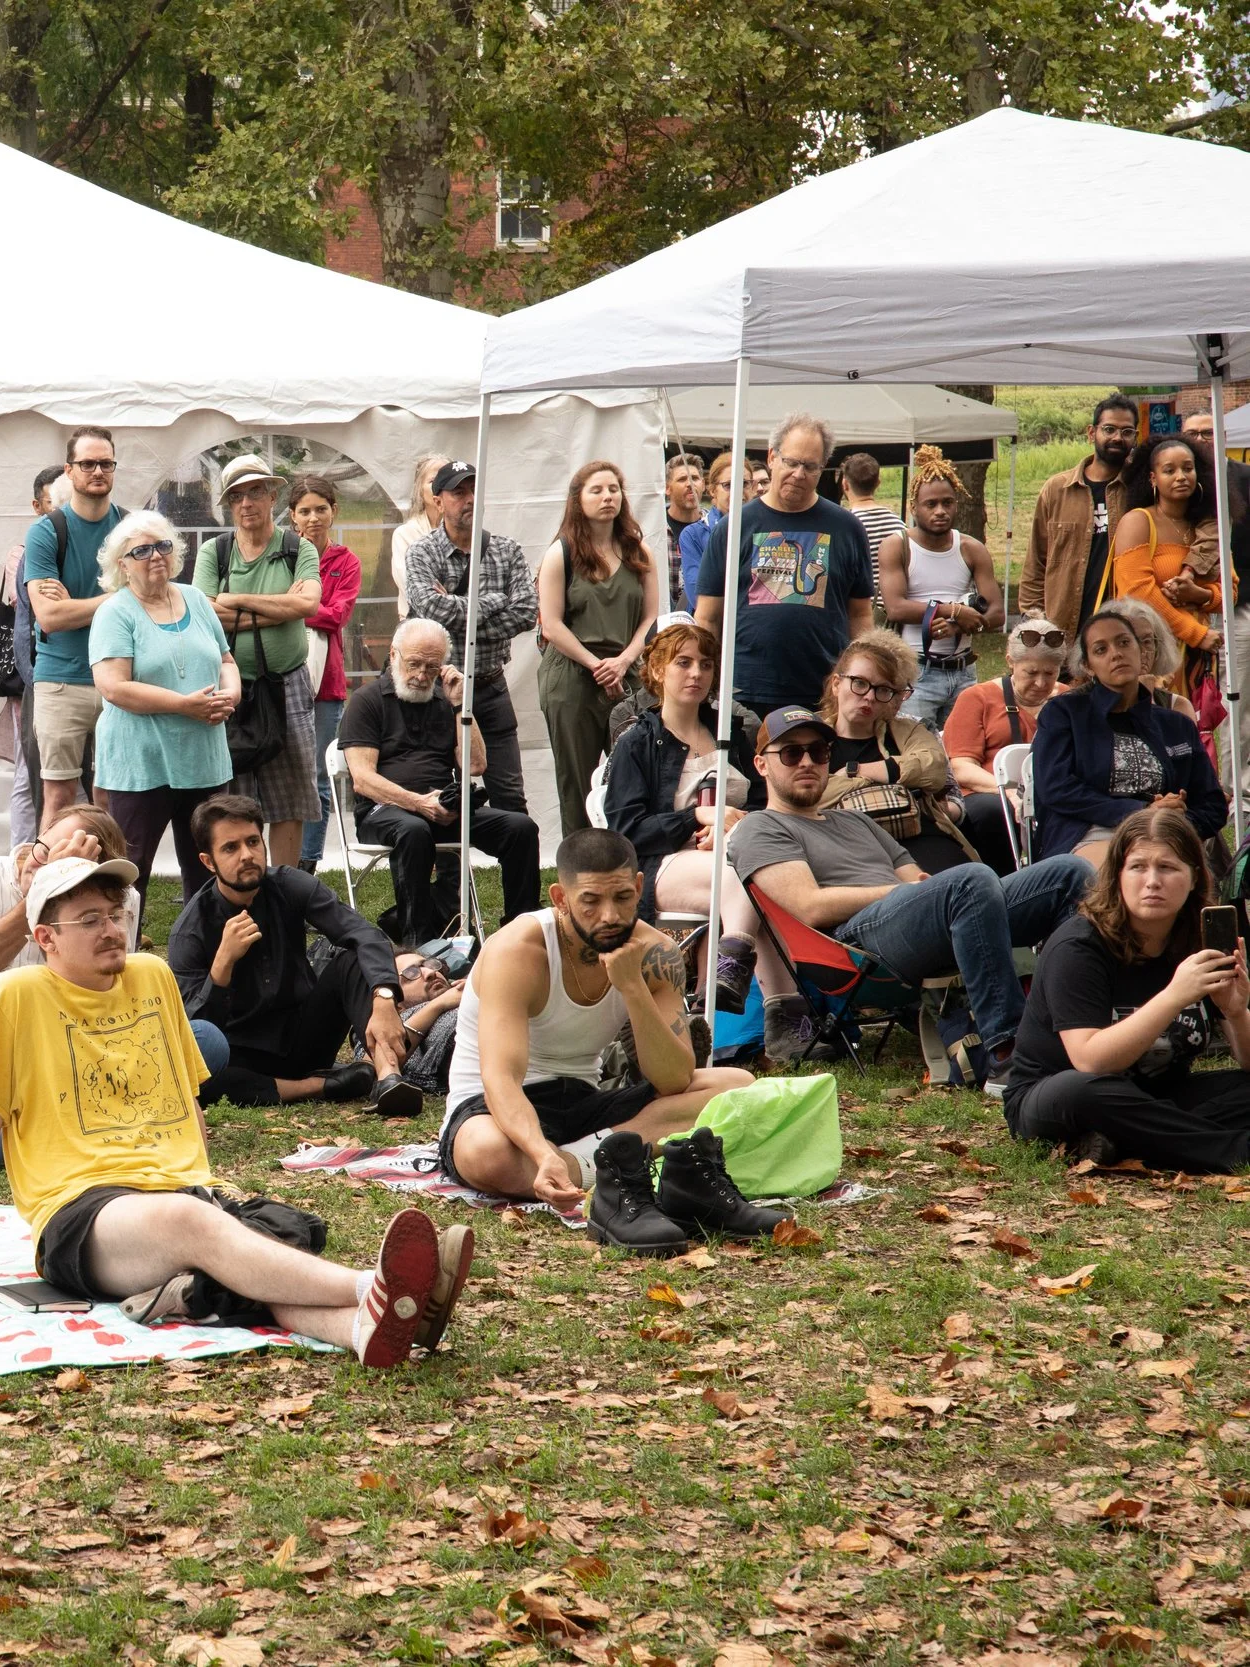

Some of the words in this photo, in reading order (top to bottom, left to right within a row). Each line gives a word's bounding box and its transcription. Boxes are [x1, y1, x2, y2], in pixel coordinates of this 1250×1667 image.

[759, 545, 796, 553] CHARLIE
[757, 557, 797, 569] JAZZ
[756, 568, 793, 576] FESTIVAL
[95, 1009, 139, 1027] SCOTIA
